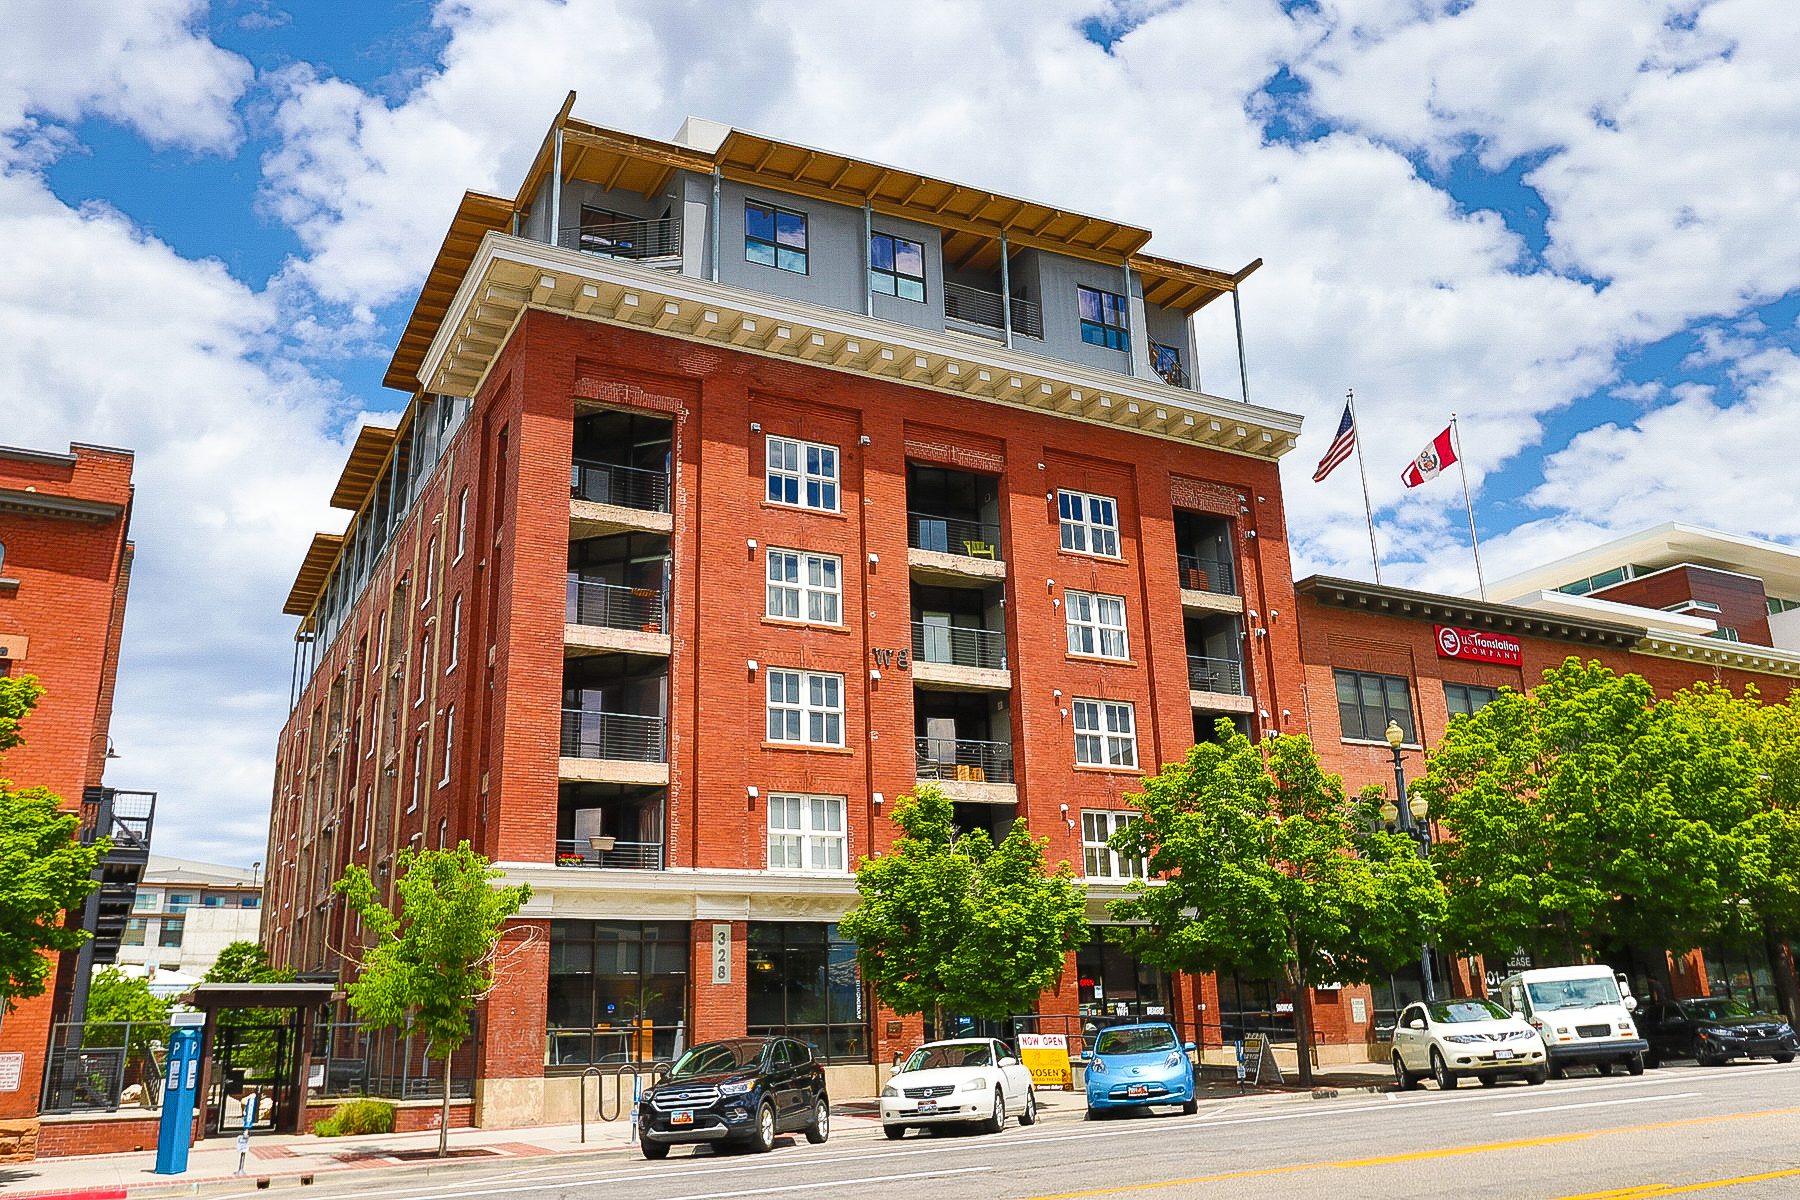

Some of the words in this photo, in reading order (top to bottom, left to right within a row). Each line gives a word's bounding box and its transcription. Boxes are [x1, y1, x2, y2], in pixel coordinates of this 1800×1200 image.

[1469, 632, 1520, 653] Translation
[1463, 646, 1518, 661] COMPANY
[717, 931, 726, 979] 328
[173, 1041, 180, 1056] P
[190, 1041, 198, 1055] P
[1022, 1036, 1039, 1046] NOW
[1043, 1036, 1063, 1046] OPEN
[1029, 1068, 1067, 1077] VOSEN'S
